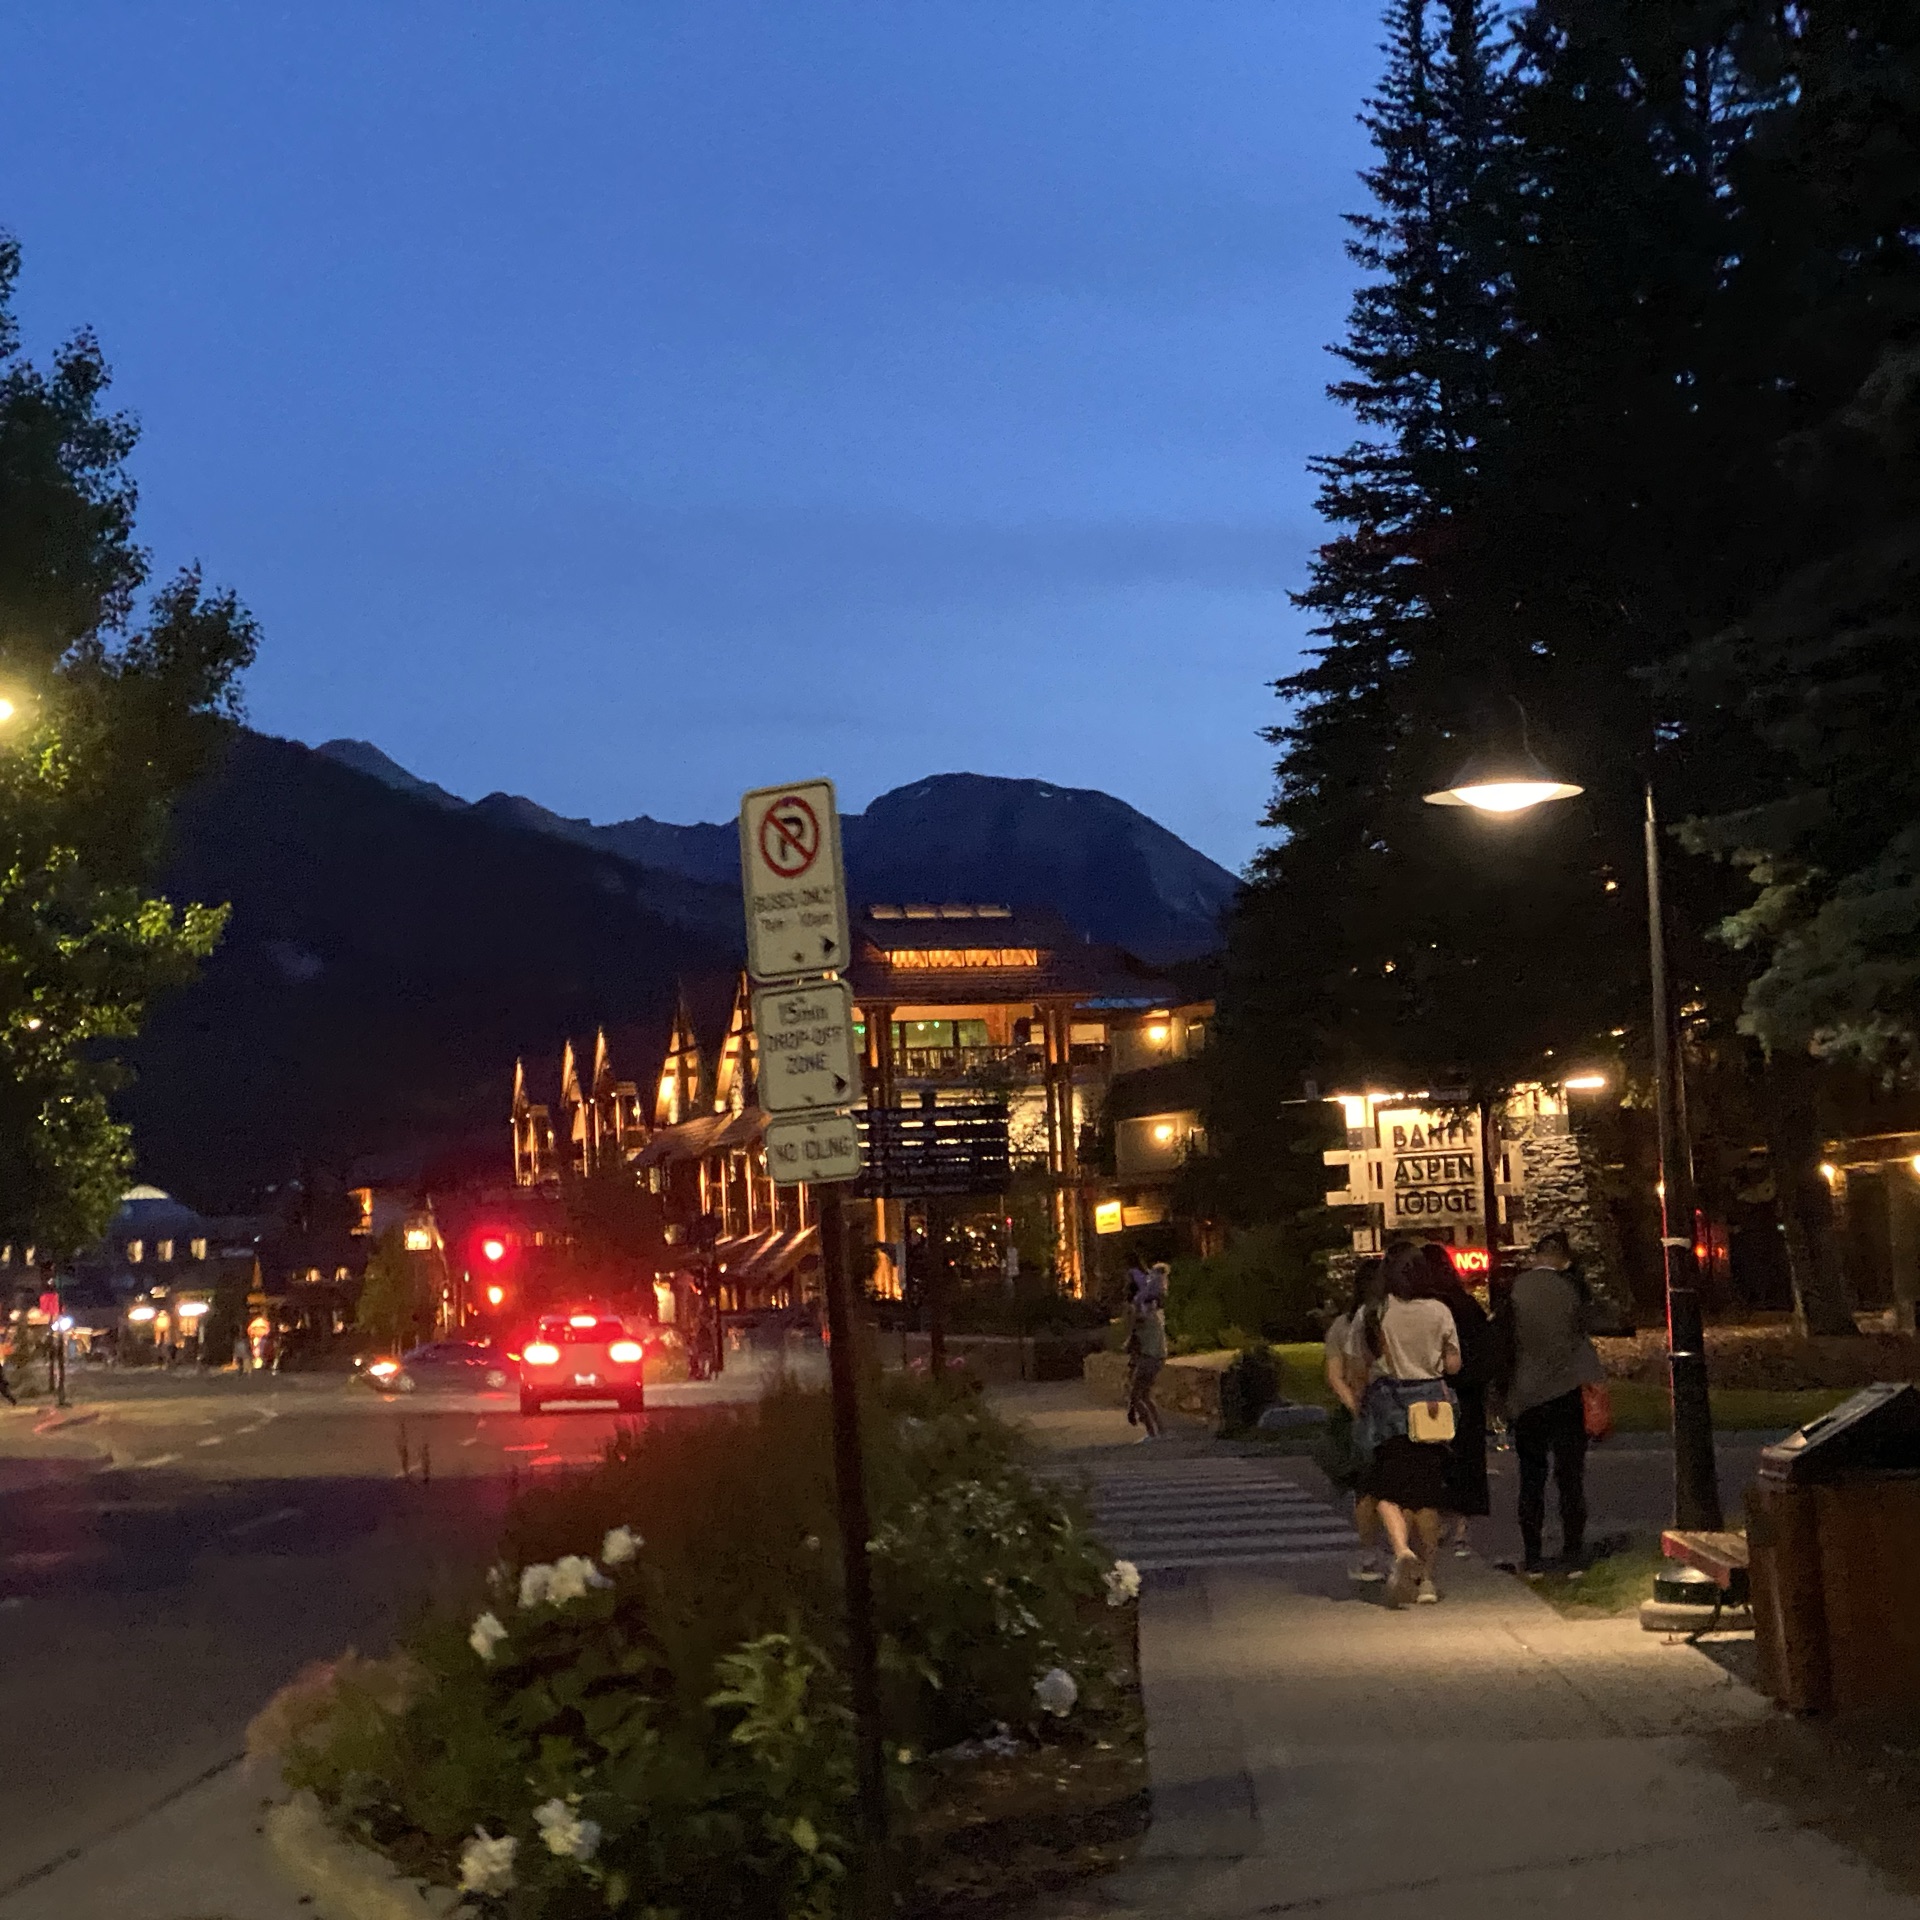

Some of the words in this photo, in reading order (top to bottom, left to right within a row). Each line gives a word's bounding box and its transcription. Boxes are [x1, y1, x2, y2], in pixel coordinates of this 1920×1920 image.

[786, 1054, 828, 1074] ZONE
[1394, 1157, 1474, 1182] ASPEN
[1395, 1189, 1477, 1215] LODGE
